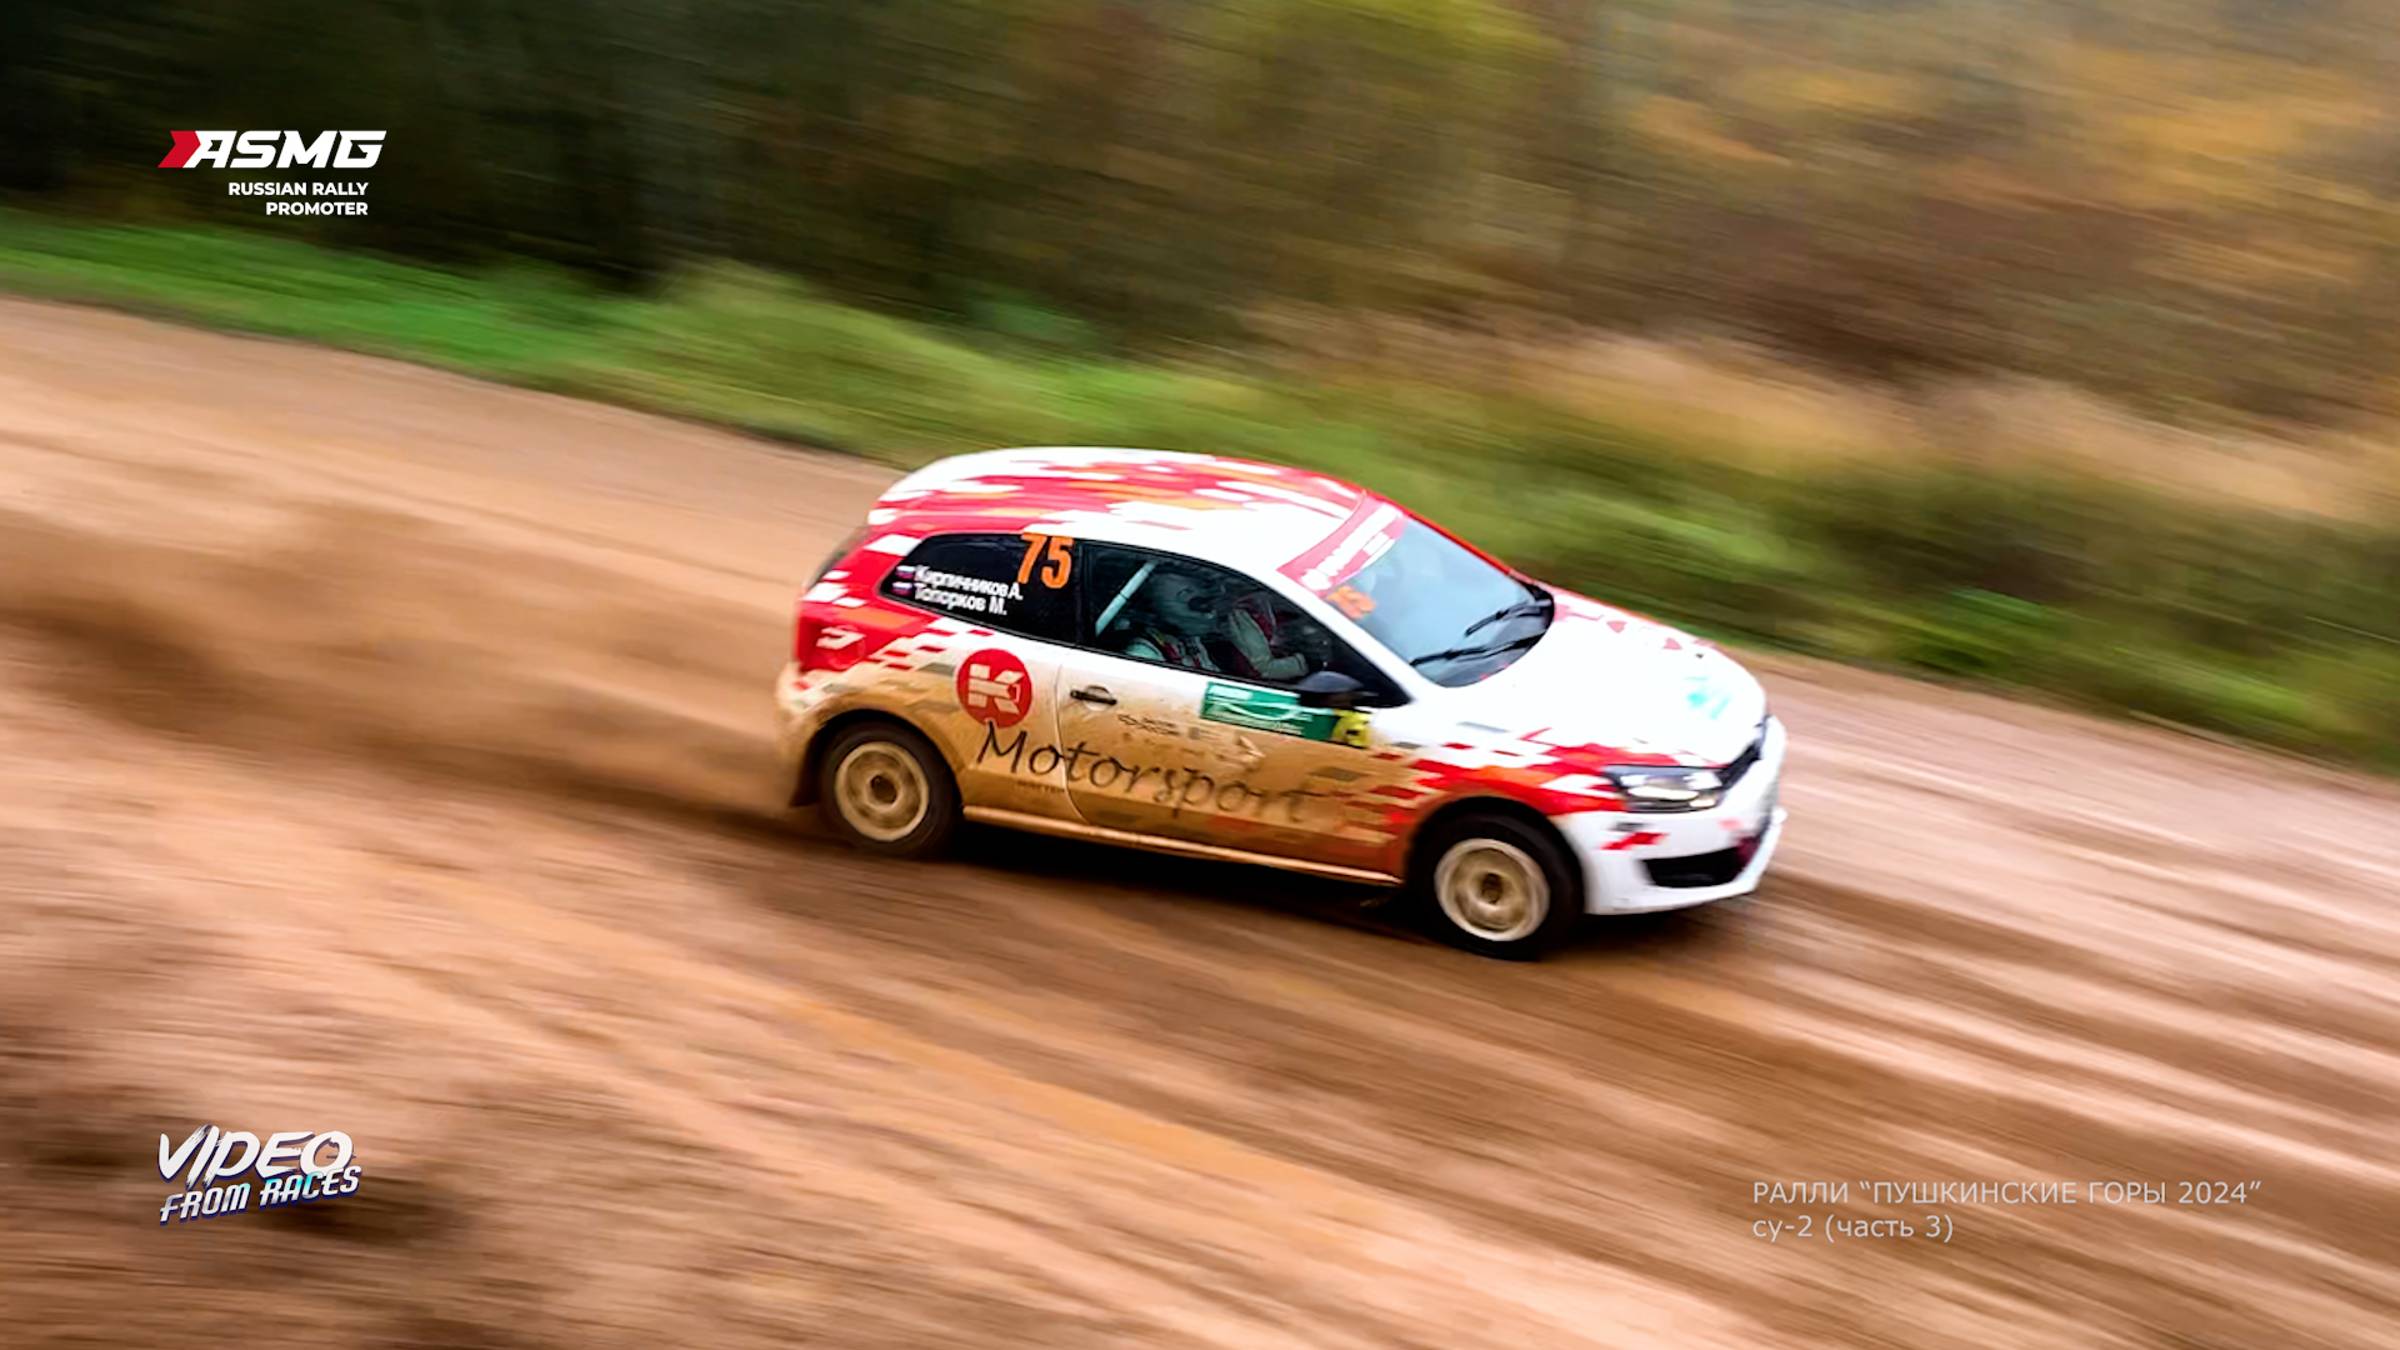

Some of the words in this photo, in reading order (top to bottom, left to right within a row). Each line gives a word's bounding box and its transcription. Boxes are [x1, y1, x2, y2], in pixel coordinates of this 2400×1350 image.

[1017, 532, 1074, 589] 75
[913, 582, 987, 612] Топорков
[988, 595, 1008, 616] М.
[976, 719, 1327, 824] Motorsport
